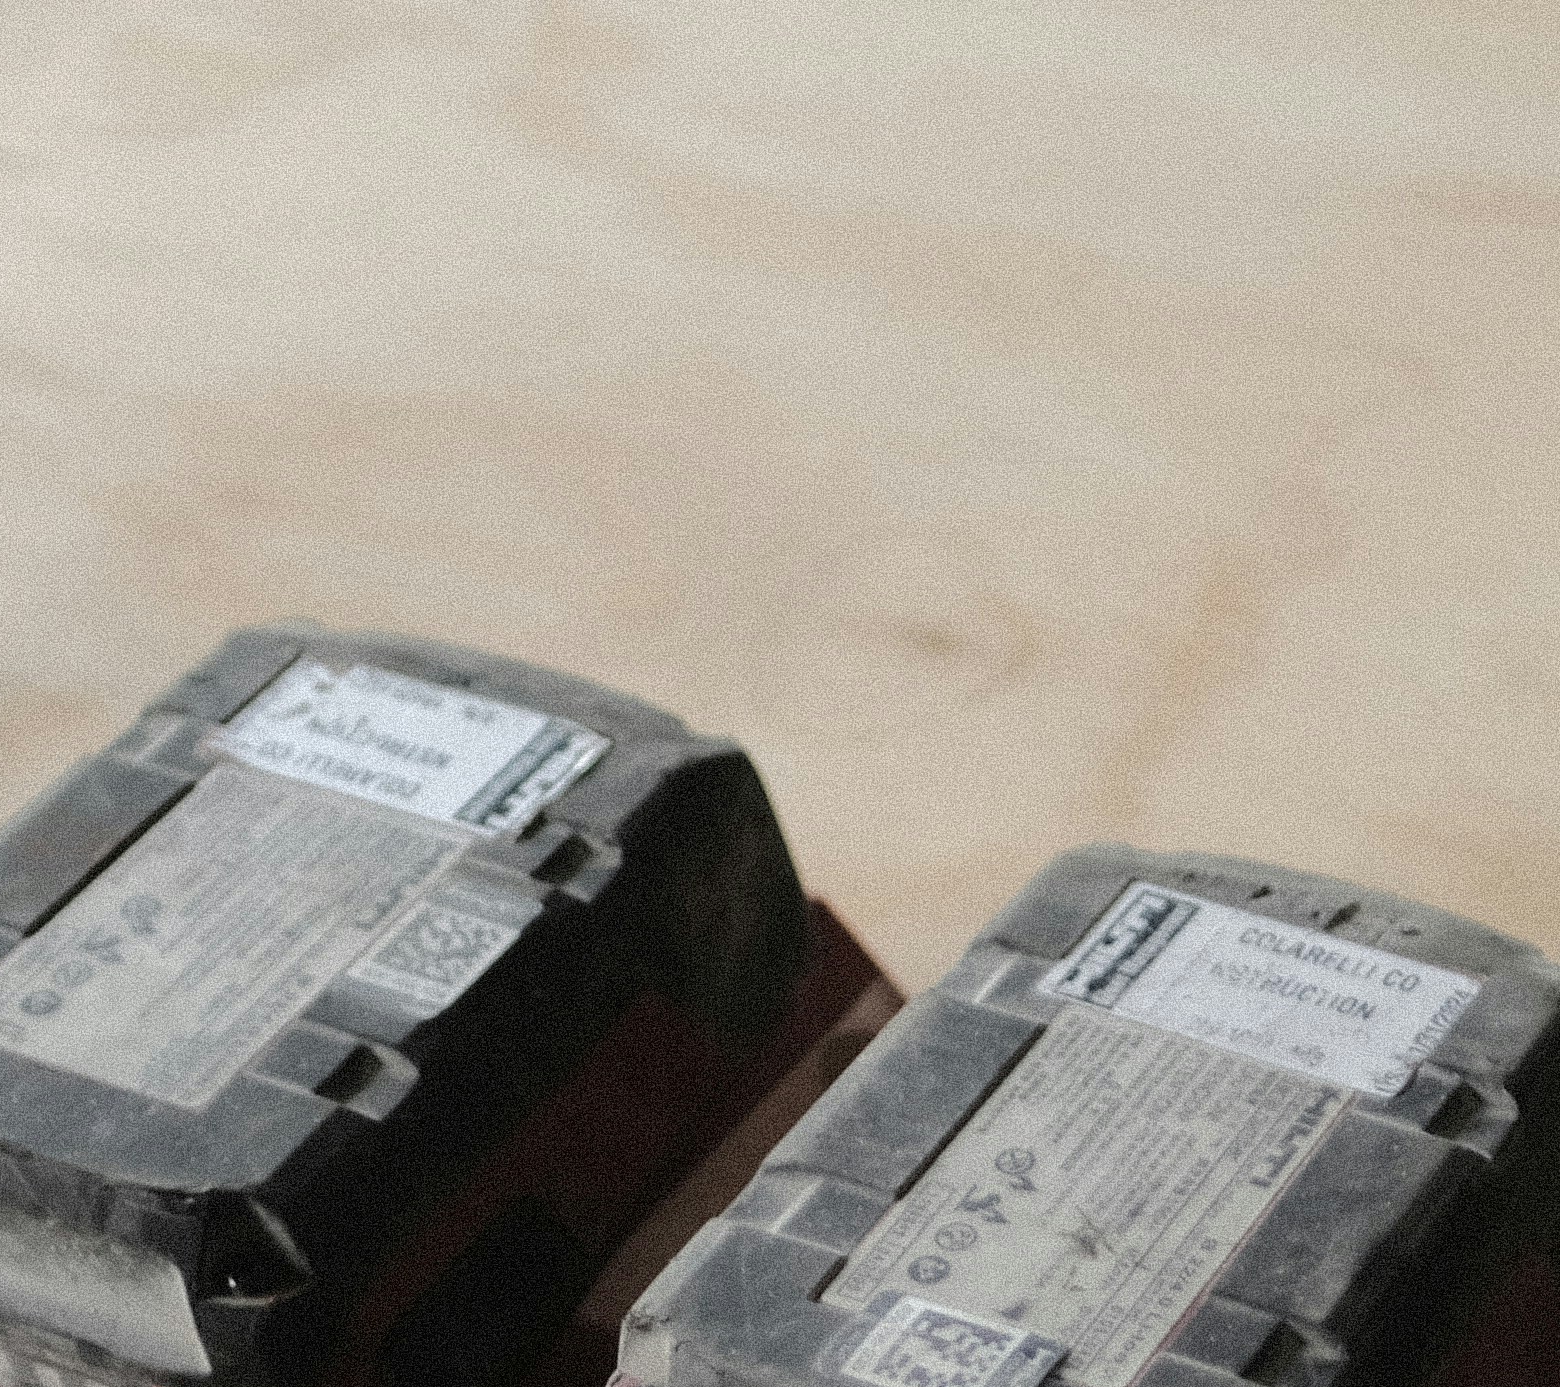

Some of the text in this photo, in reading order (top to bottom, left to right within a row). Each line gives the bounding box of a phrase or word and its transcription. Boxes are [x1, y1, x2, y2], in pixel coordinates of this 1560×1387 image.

[1057, 894, 1169, 993] HILTI
[1234, 925, 1384, 981] COLARELLI
[1377, 967, 1426, 994] CO
[1252, 1089, 1342, 1190] HILTI
